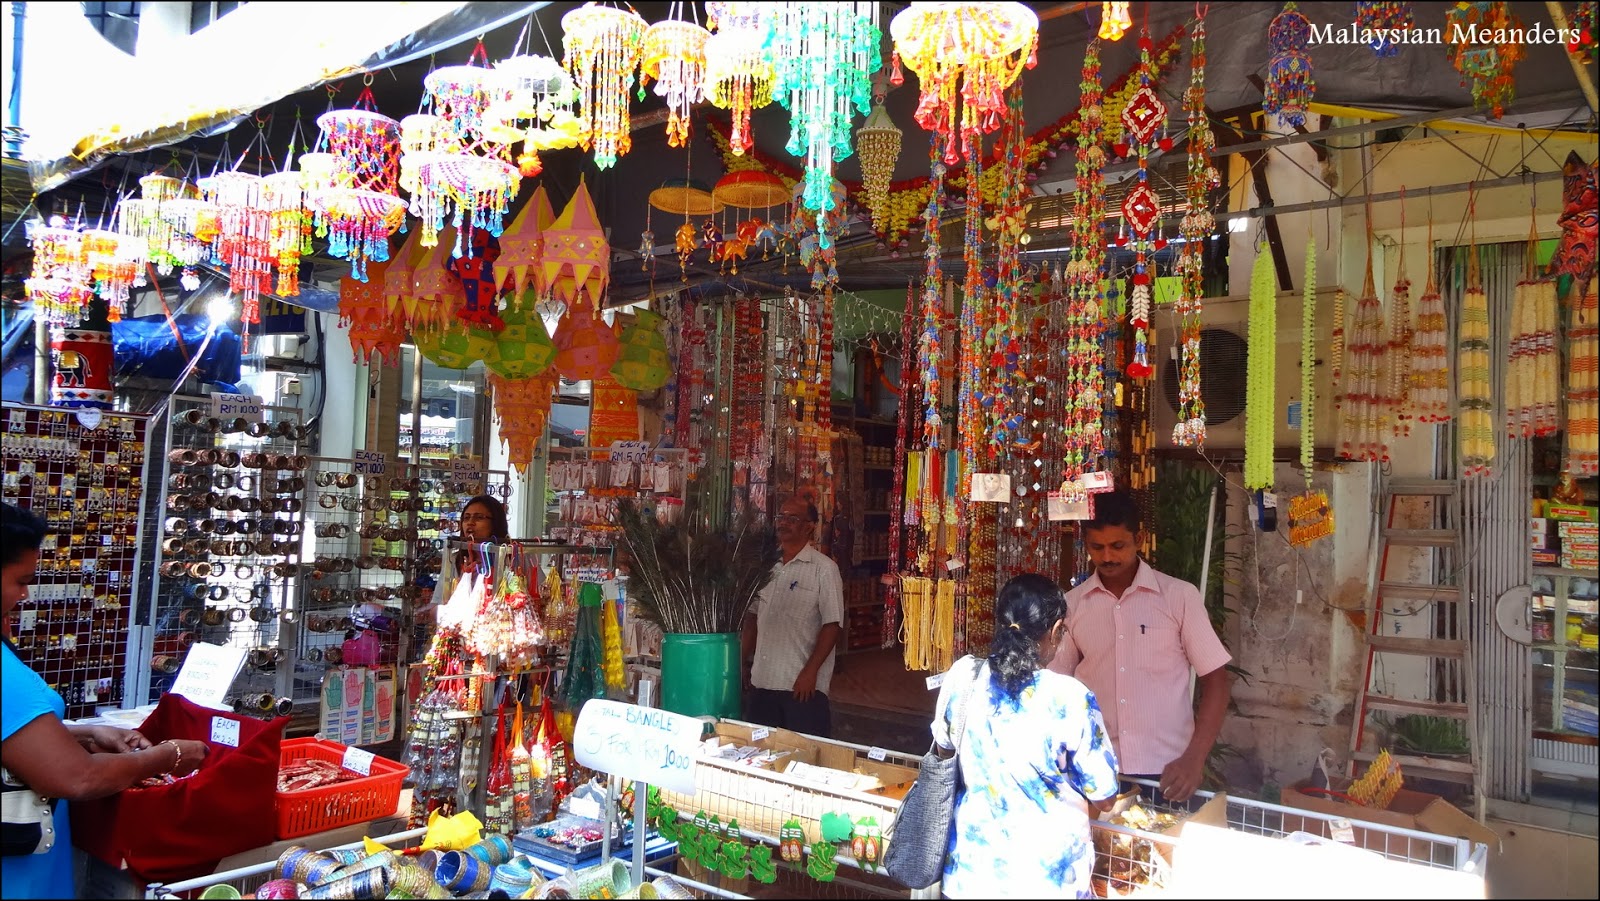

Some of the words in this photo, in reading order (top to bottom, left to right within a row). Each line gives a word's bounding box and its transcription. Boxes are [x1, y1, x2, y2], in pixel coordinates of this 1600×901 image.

[220, 395, 252, 404] EACH
[220, 404, 237, 413] RM
[355, 451, 385, 463] EACH
[611, 451, 623, 461] RM
[354, 462, 368, 473] RM
[454, 472, 467, 480] RM
[216, 718, 237, 730] EACH
[607, 732, 632, 755] FOR
